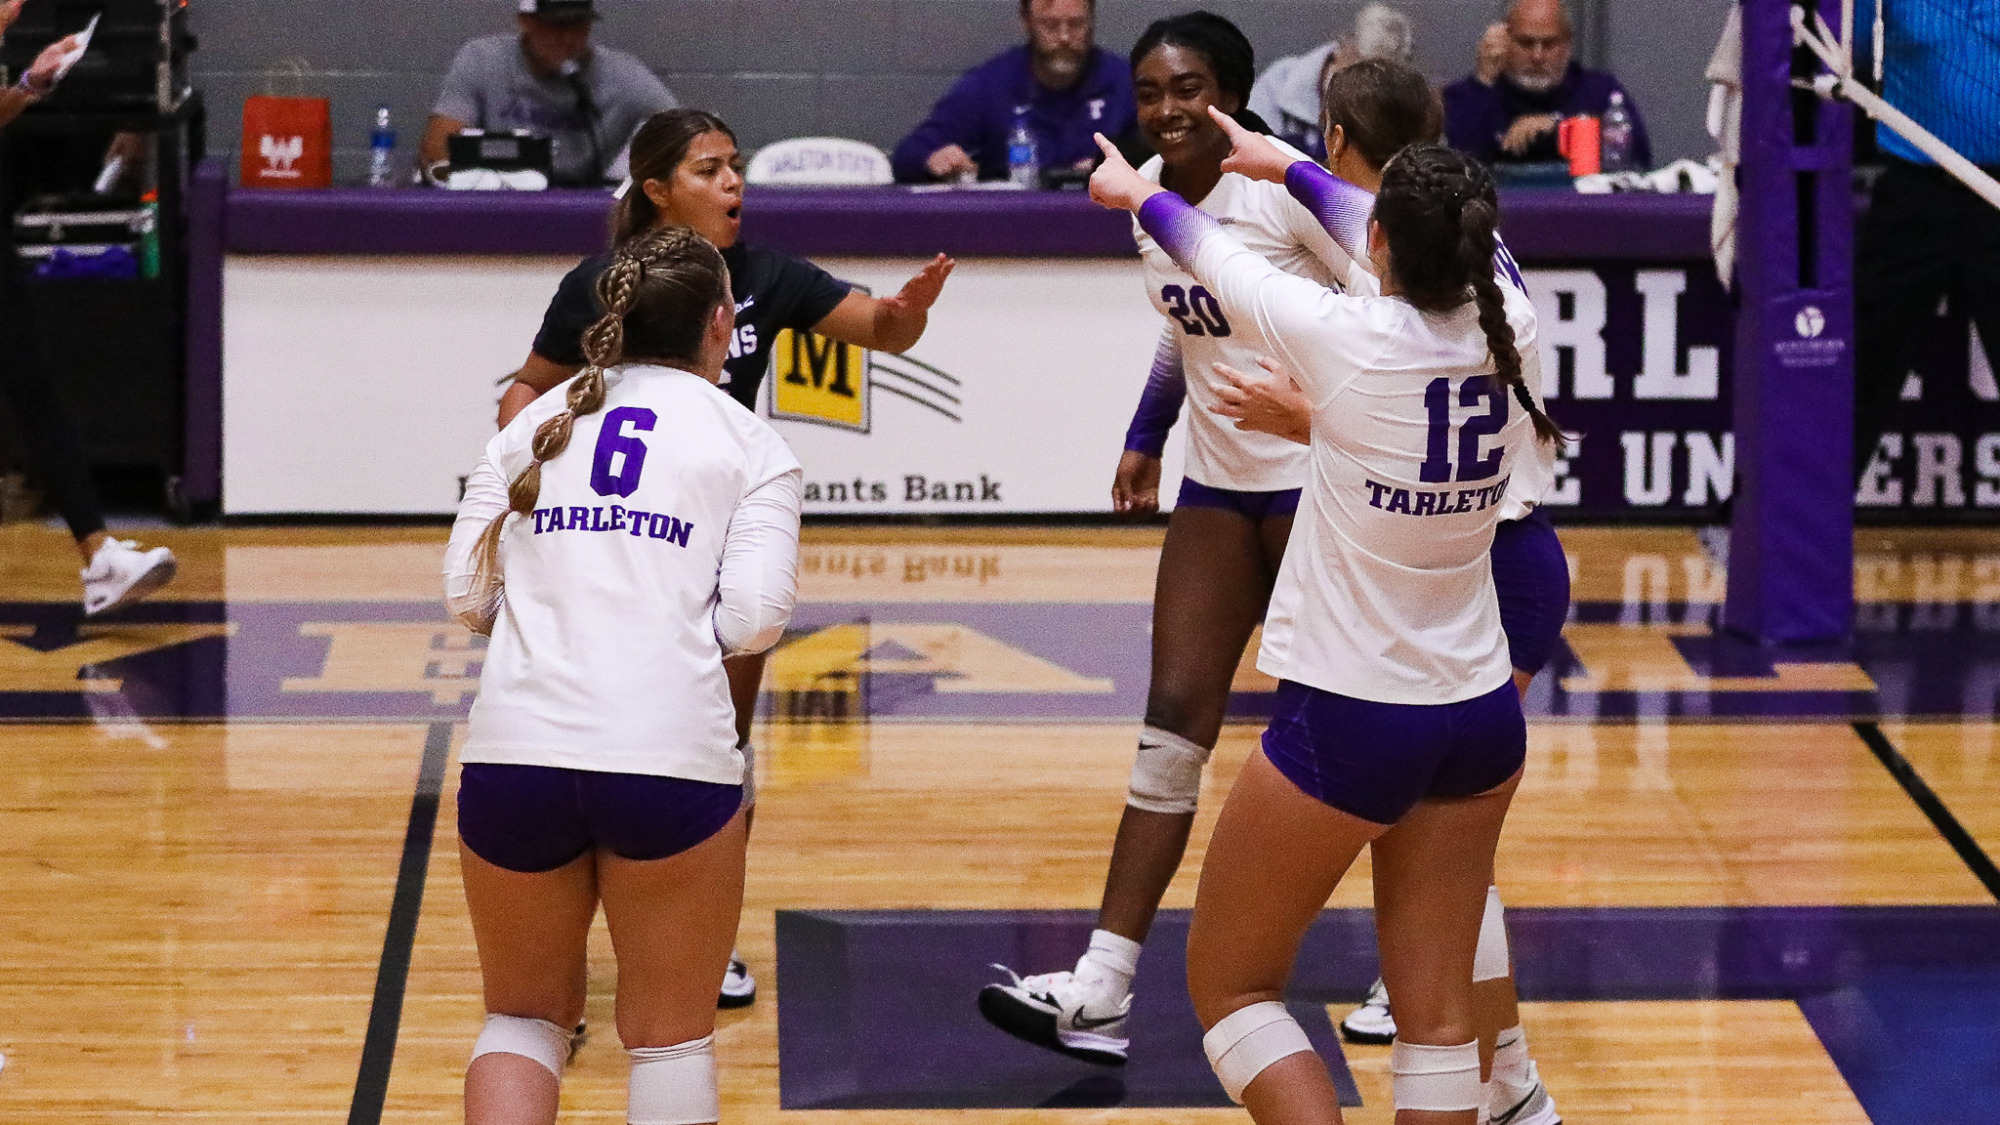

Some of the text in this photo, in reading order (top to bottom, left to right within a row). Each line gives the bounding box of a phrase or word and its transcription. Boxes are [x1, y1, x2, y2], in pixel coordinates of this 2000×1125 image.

[1161, 284, 1232, 338] 20
[590, 406, 658, 499] 6
[1419, 373, 1509, 483] 12
[904, 473, 1001, 502] Bank
[531, 505, 695, 549] TARLETON
